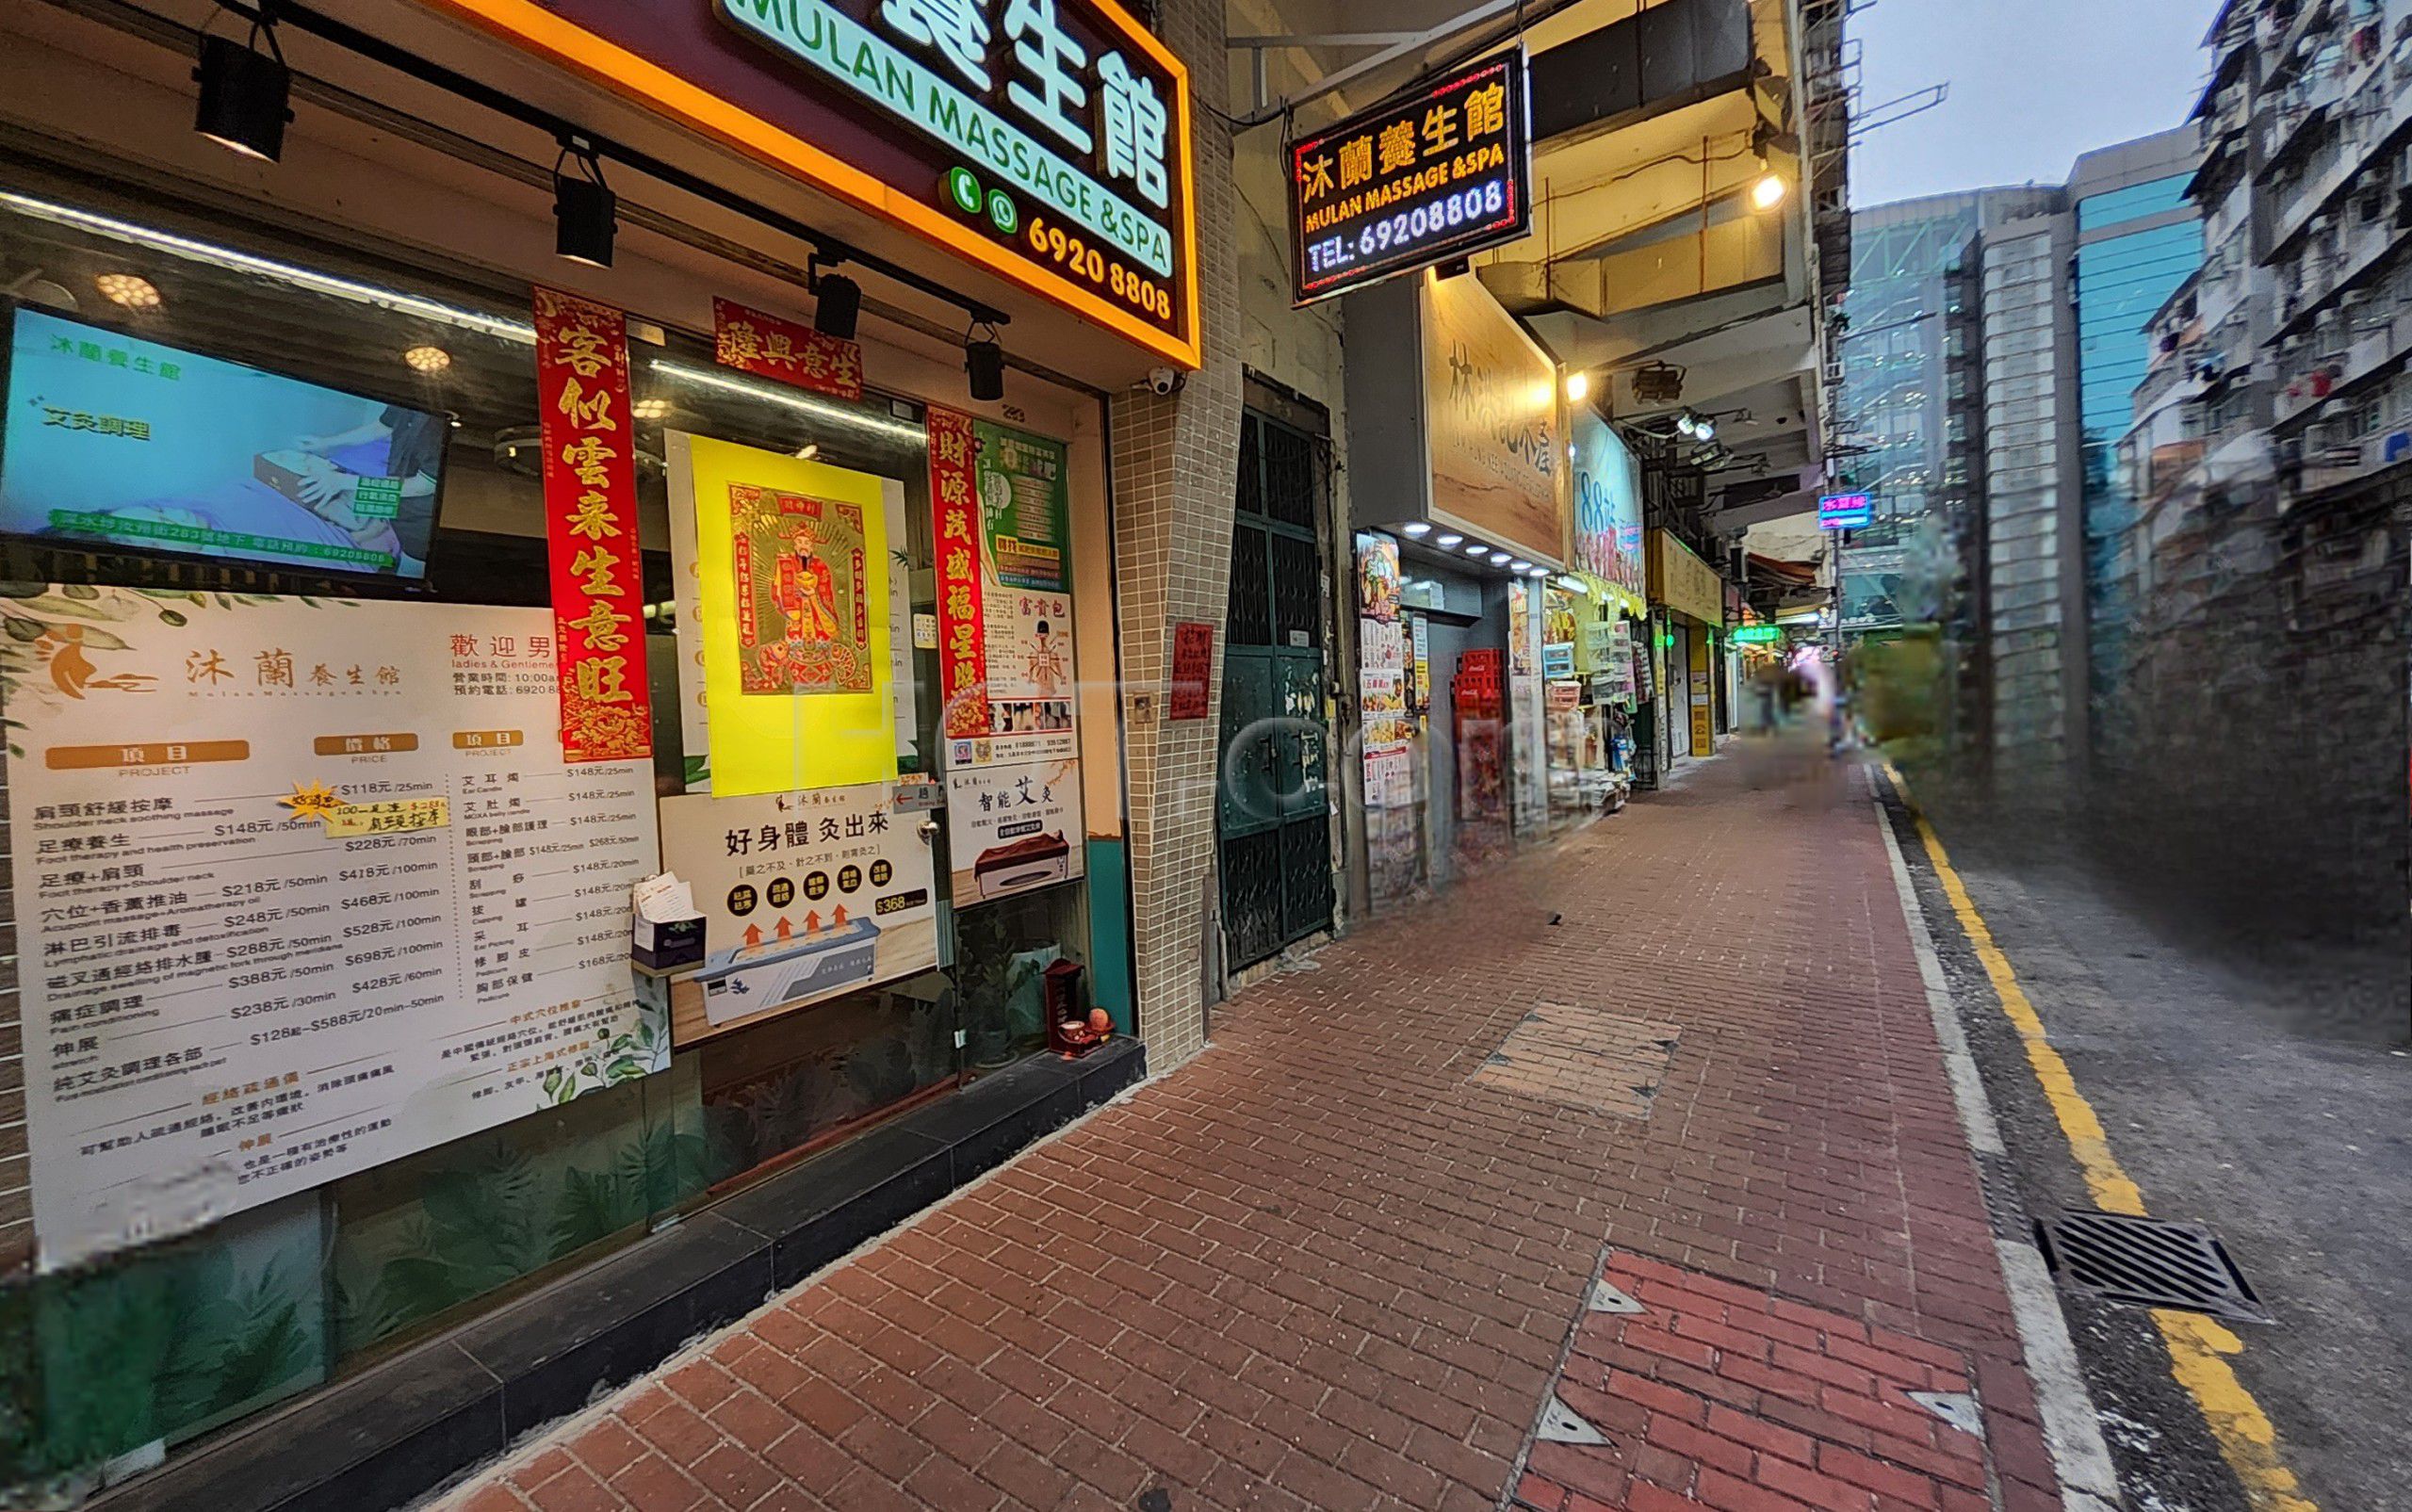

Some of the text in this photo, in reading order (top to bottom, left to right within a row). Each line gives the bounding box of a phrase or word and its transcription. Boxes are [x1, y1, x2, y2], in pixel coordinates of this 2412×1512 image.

[1302, 81, 1506, 204] 沐蘭養生館
[929, 84, 1092, 222] MASSAGE
[1100, 197, 1167, 270] &SPA
[1306, 142, 1505, 234] MULAN MASSAGE &SPA
[1029, 218, 1171, 321] 6920 8808
[41, 406, 152, 442] 艾灸調理
[554, 326, 634, 703] 客似雲來生意旺
[938, 430, 976, 689] 財源茂盛福星照
[450, 633, 551, 658] 歡迎男
[186, 647, 401, 689] 沐蘭養生館
[119, 766, 191, 778] PROJECT
[122, 745, 188, 764] 項目
[351, 755, 388, 764] PRICE
[977, 774, 1054, 812] 智能艾灸
[36, 834, 131, 854] 足療養生
[725, 810, 889, 857] 好身體 灸出來
